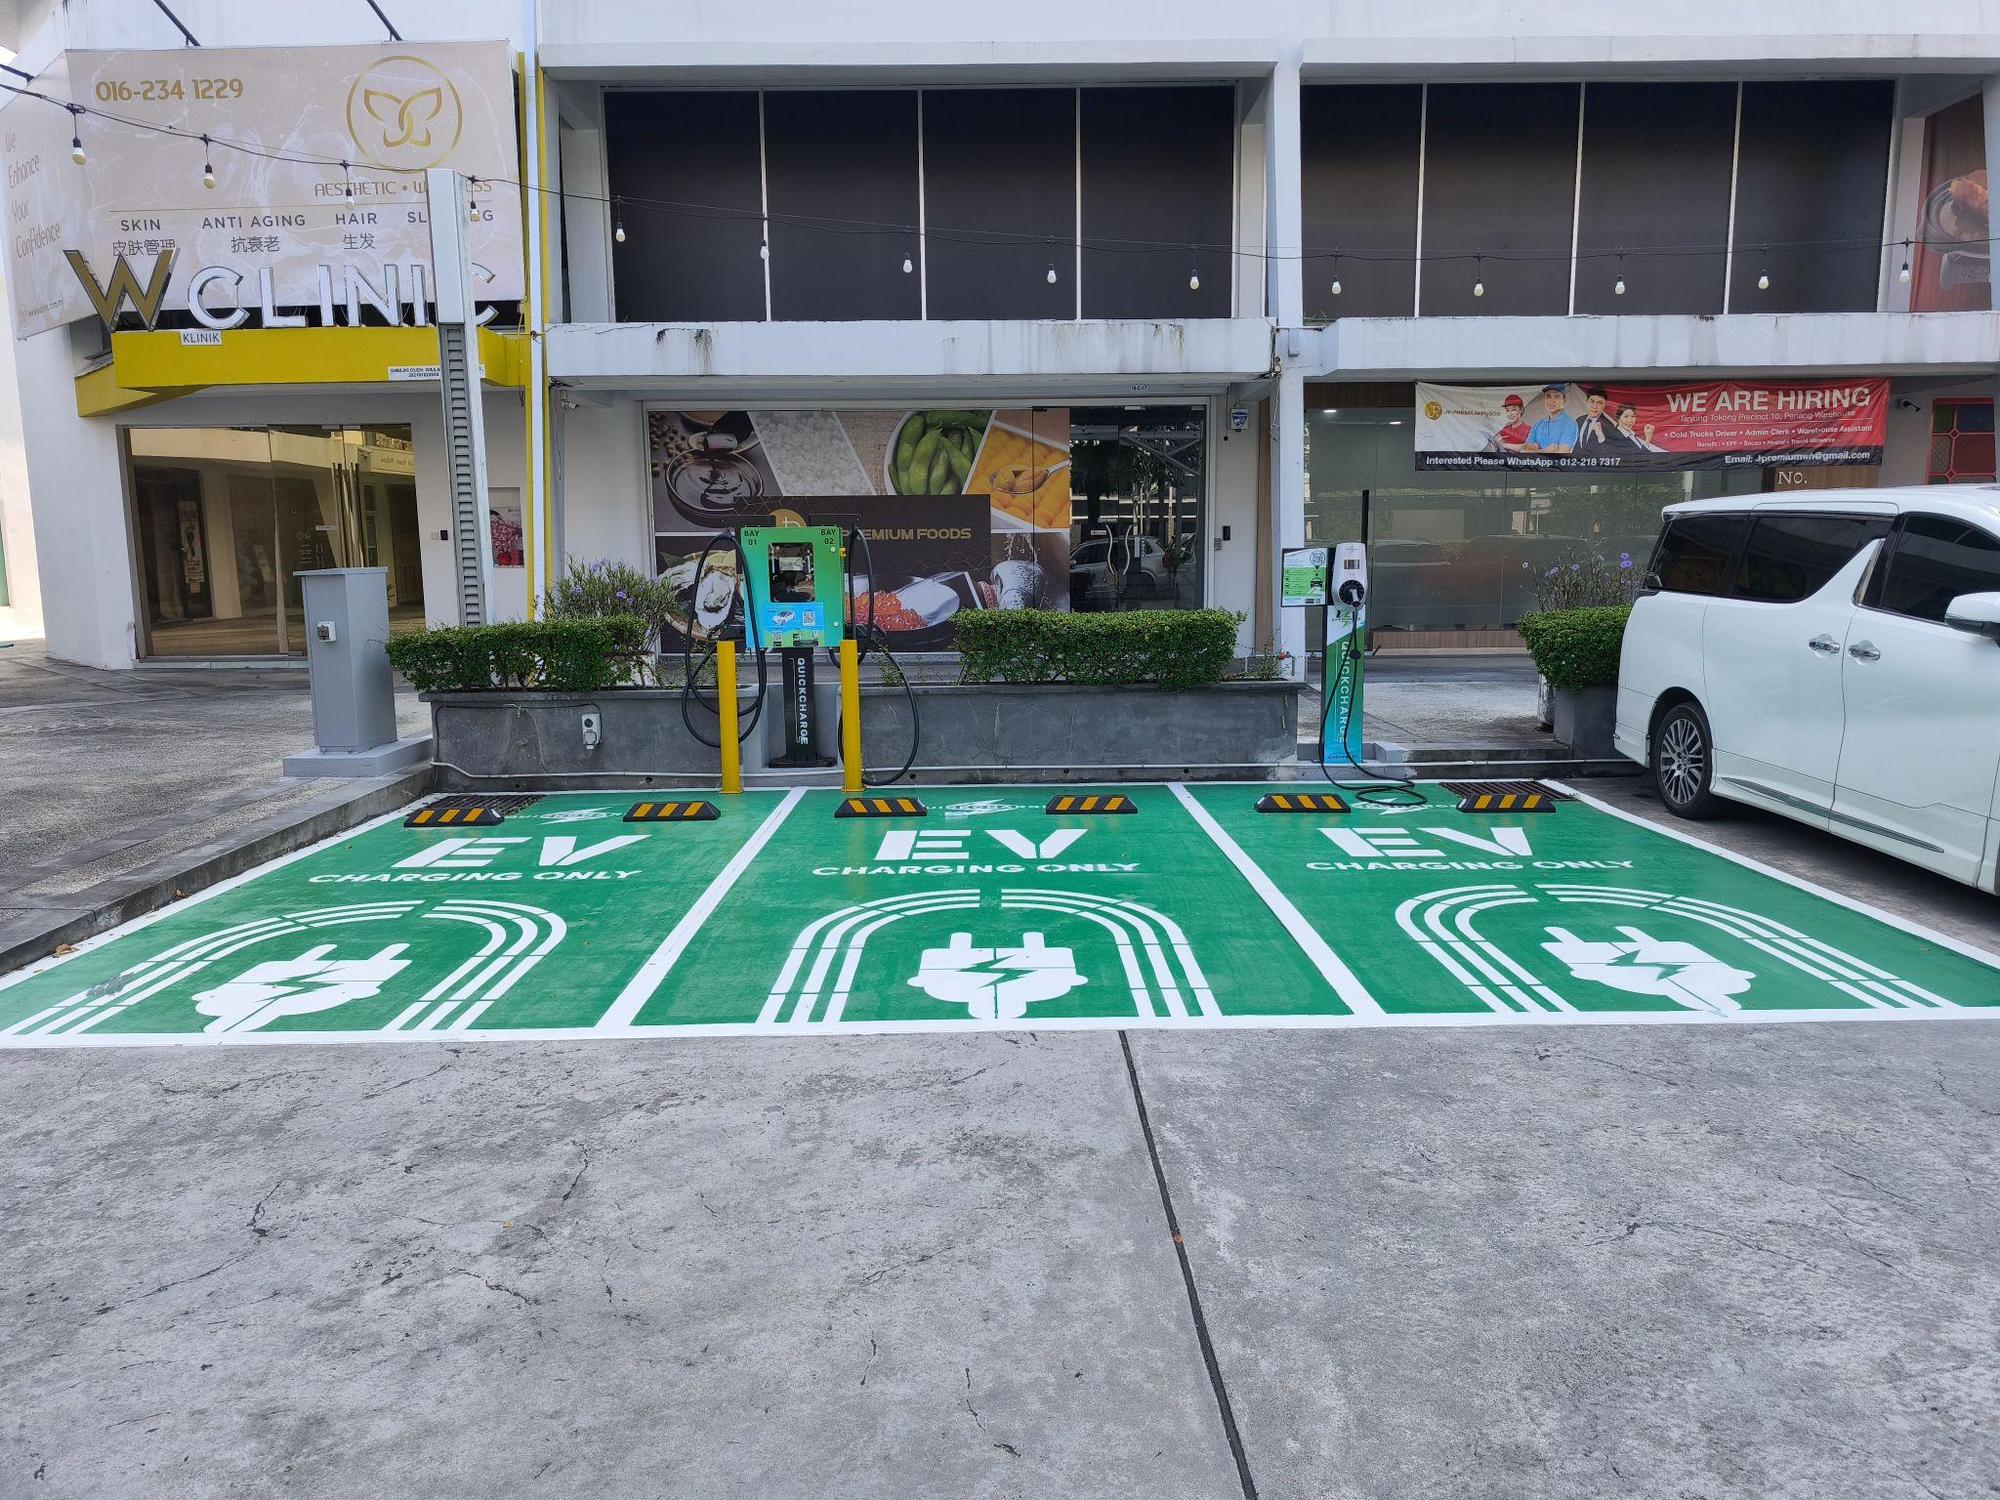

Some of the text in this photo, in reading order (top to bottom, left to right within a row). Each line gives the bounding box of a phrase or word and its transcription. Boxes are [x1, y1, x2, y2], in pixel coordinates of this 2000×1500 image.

[95, 78, 244, 101] 016-234 1229
[314, 180, 397, 197] AESTHETIC
[120, 219, 161, 232] SKIN
[202, 214, 306, 230] ANTI AGING
[335, 212, 378, 225] HAIR
[231, 235, 281, 254] 抗衰老
[343, 232, 376, 250] 生发
[64, 249, 180, 332] W
[182, 332, 221, 343] KLINIK
[1666, 387, 1871, 413] WE ARE HIRING
[1669, 424, 1873, 439] Cold Trucks Driver Admin Clerk Warehouse Assistant
[1426, 456, 1621, 468] Interested Please WhatsApp 012-218 7317
[1724, 455, 1753, 464] Email:
[1777, 471, 1808, 485] No.
[917, 527, 972, 540] FOODS
[748, 538, 758, 546] 01
[797, 657, 809, 745] QUICKCHARGE
[874, 828, 1089, 860] EV
[1317, 826, 1533, 857] EV
[391, 834, 652, 868] EV
[812, 862, 1143, 877] CHARGING ONLY
[1305, 859, 1635, 871] CHARGING ONLY
[308, 869, 643, 884] CHARGING ONLY
